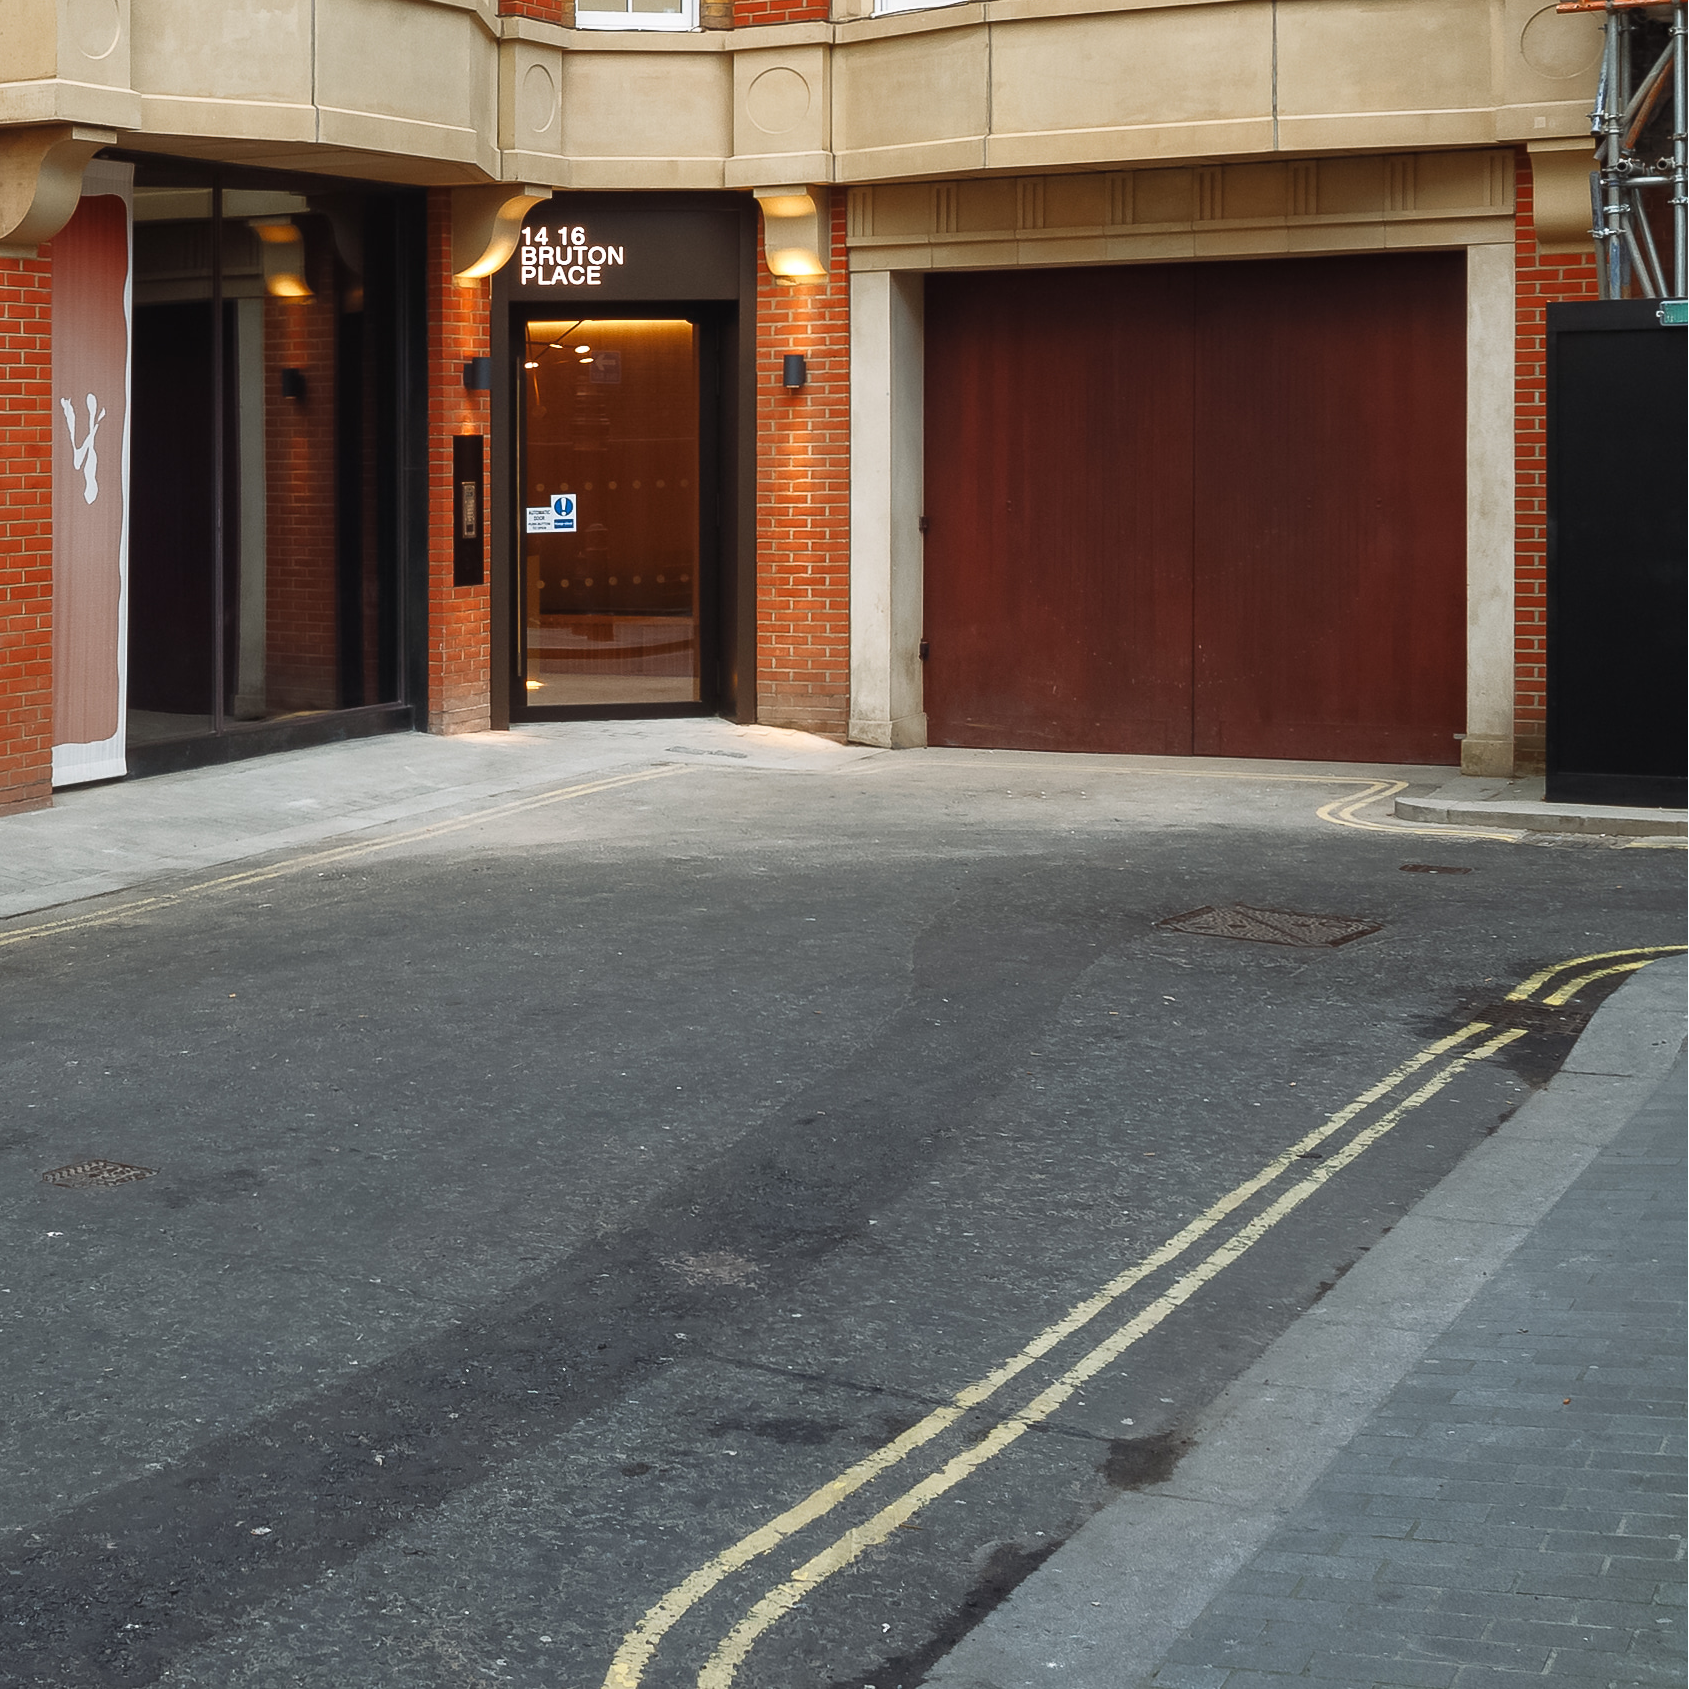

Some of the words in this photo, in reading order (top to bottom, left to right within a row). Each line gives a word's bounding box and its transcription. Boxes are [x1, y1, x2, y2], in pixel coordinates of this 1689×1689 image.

[521, 226, 549, 246] 14
[557, 226, 586, 246] 16
[521, 246, 624, 266] BRUTON
[521, 265, 602, 286] PLACE
